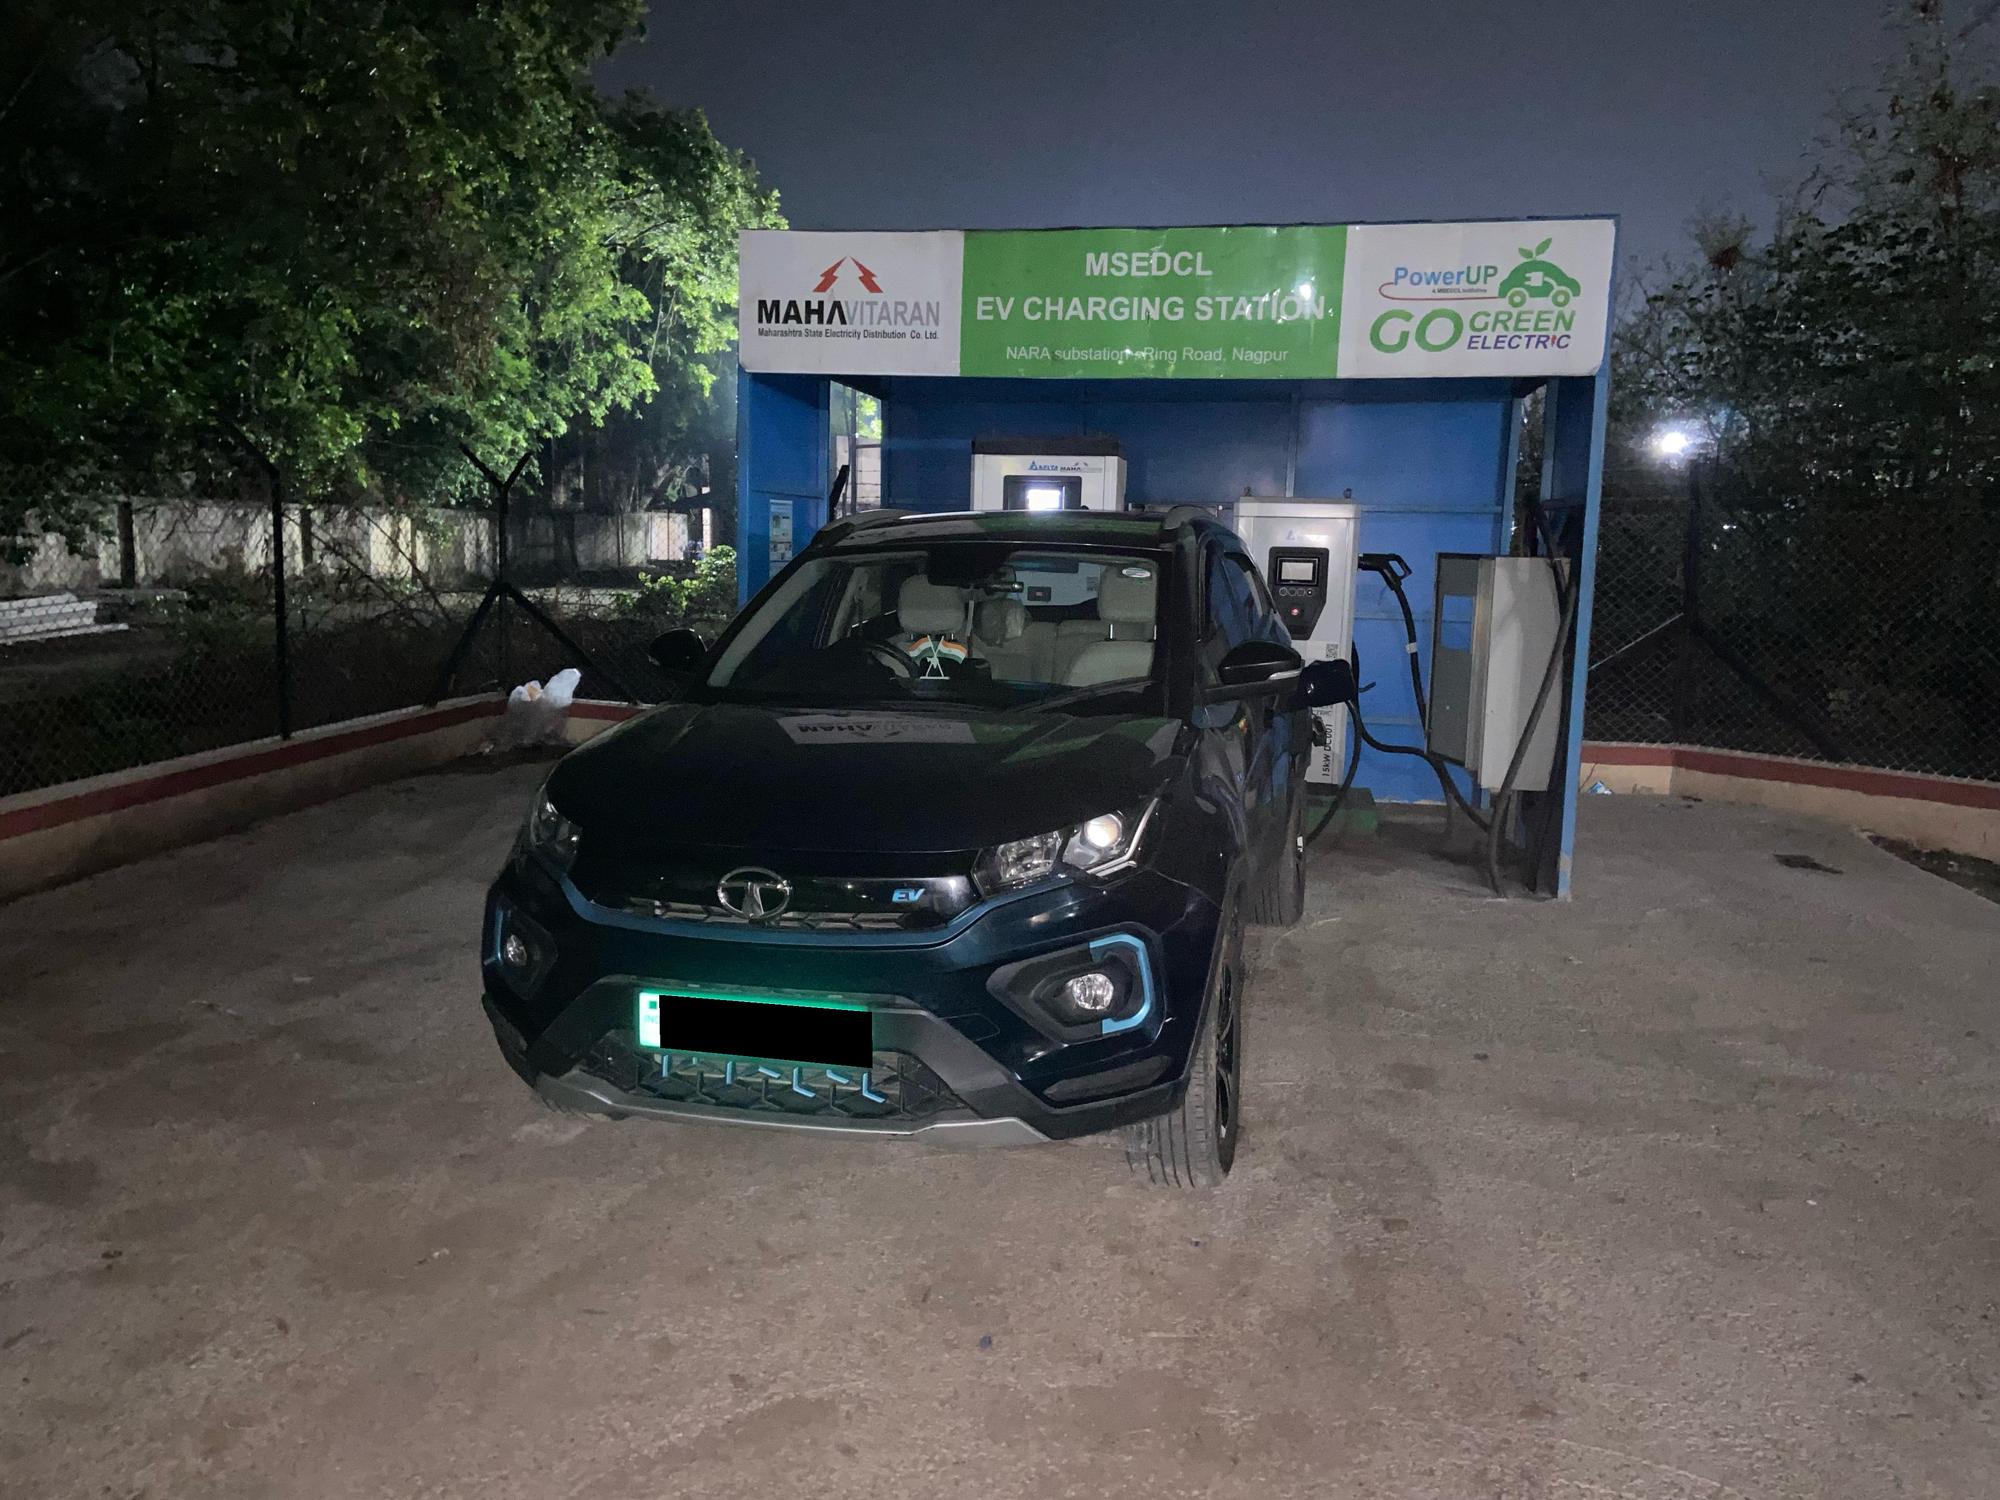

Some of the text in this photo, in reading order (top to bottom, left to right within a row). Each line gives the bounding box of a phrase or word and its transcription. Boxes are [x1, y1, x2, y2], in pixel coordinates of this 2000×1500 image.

[1085, 251, 1213, 277] MSEDCL
[1393, 265, 1498, 286] PowerUP
[757, 300, 940, 327] MAHAVITARAN
[976, 295, 1325, 321] EV CHARGING STATION
[1369, 308, 1464, 354] GO
[1468, 310, 1576, 333] GREEN
[758, 328, 803, 338] Maharashtra
[804, 328, 823, 338] State
[825, 329, 861, 340] Electricity
[863, 329, 907, 339] Distribution
[1466, 334, 1572, 350] ELECTRIC
[1006, 346, 1050, 361] NARA
[1143, 346, 1177, 364] Ring
[1232, 347, 1289, 365] Nagpur
[892, 888, 925, 902] EV
